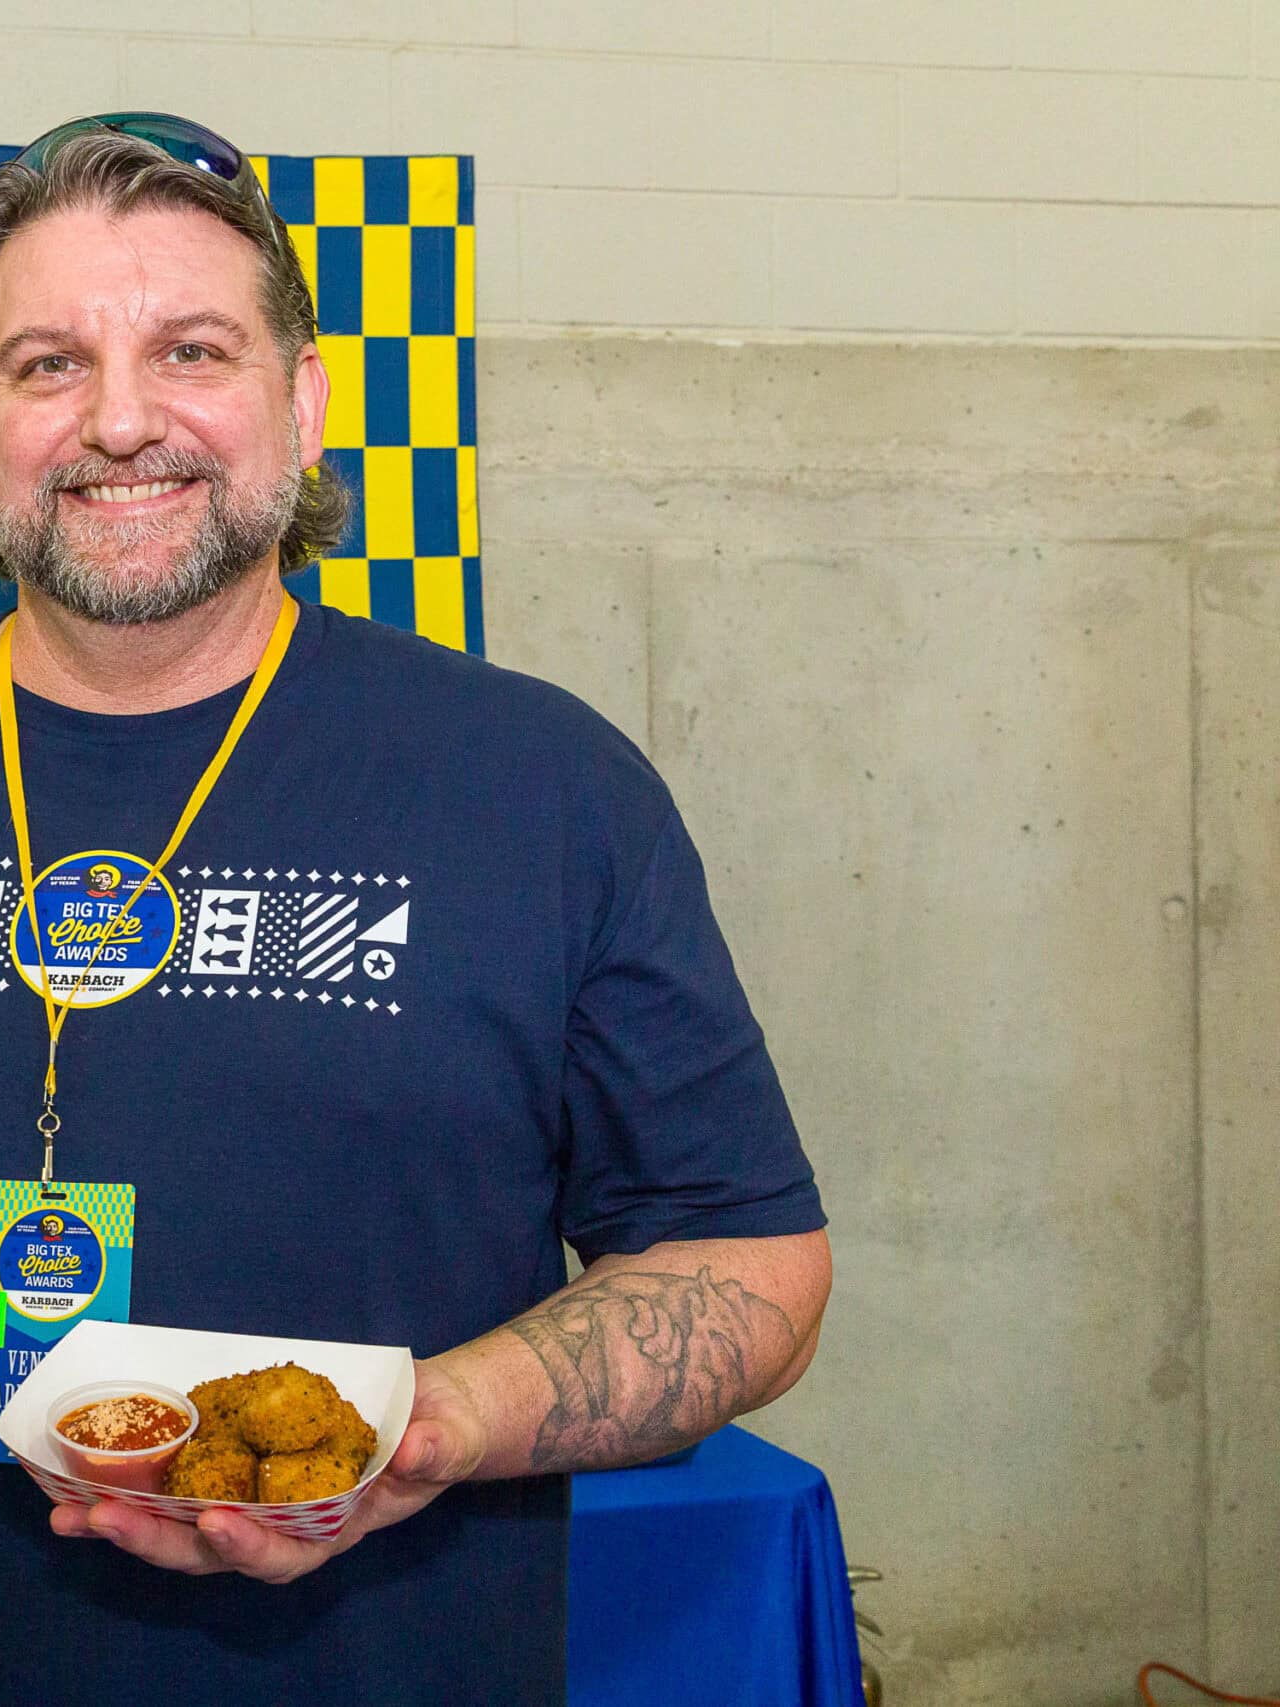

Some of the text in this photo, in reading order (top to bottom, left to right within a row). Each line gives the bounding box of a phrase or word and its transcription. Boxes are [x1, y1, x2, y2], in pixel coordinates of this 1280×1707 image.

[62, 901, 93, 918] BIG
[47, 915, 143, 947] Choice
[48, 974, 126, 986] KARBACH
[27, 1244, 72, 1257] BIG TEX
[18, 1253, 81, 1277] Choice
[25, 1275, 74, 1288] AWARDS
[21, 1296, 74, 1307] KARBACH
[8, 1349, 50, 1376] VEN
